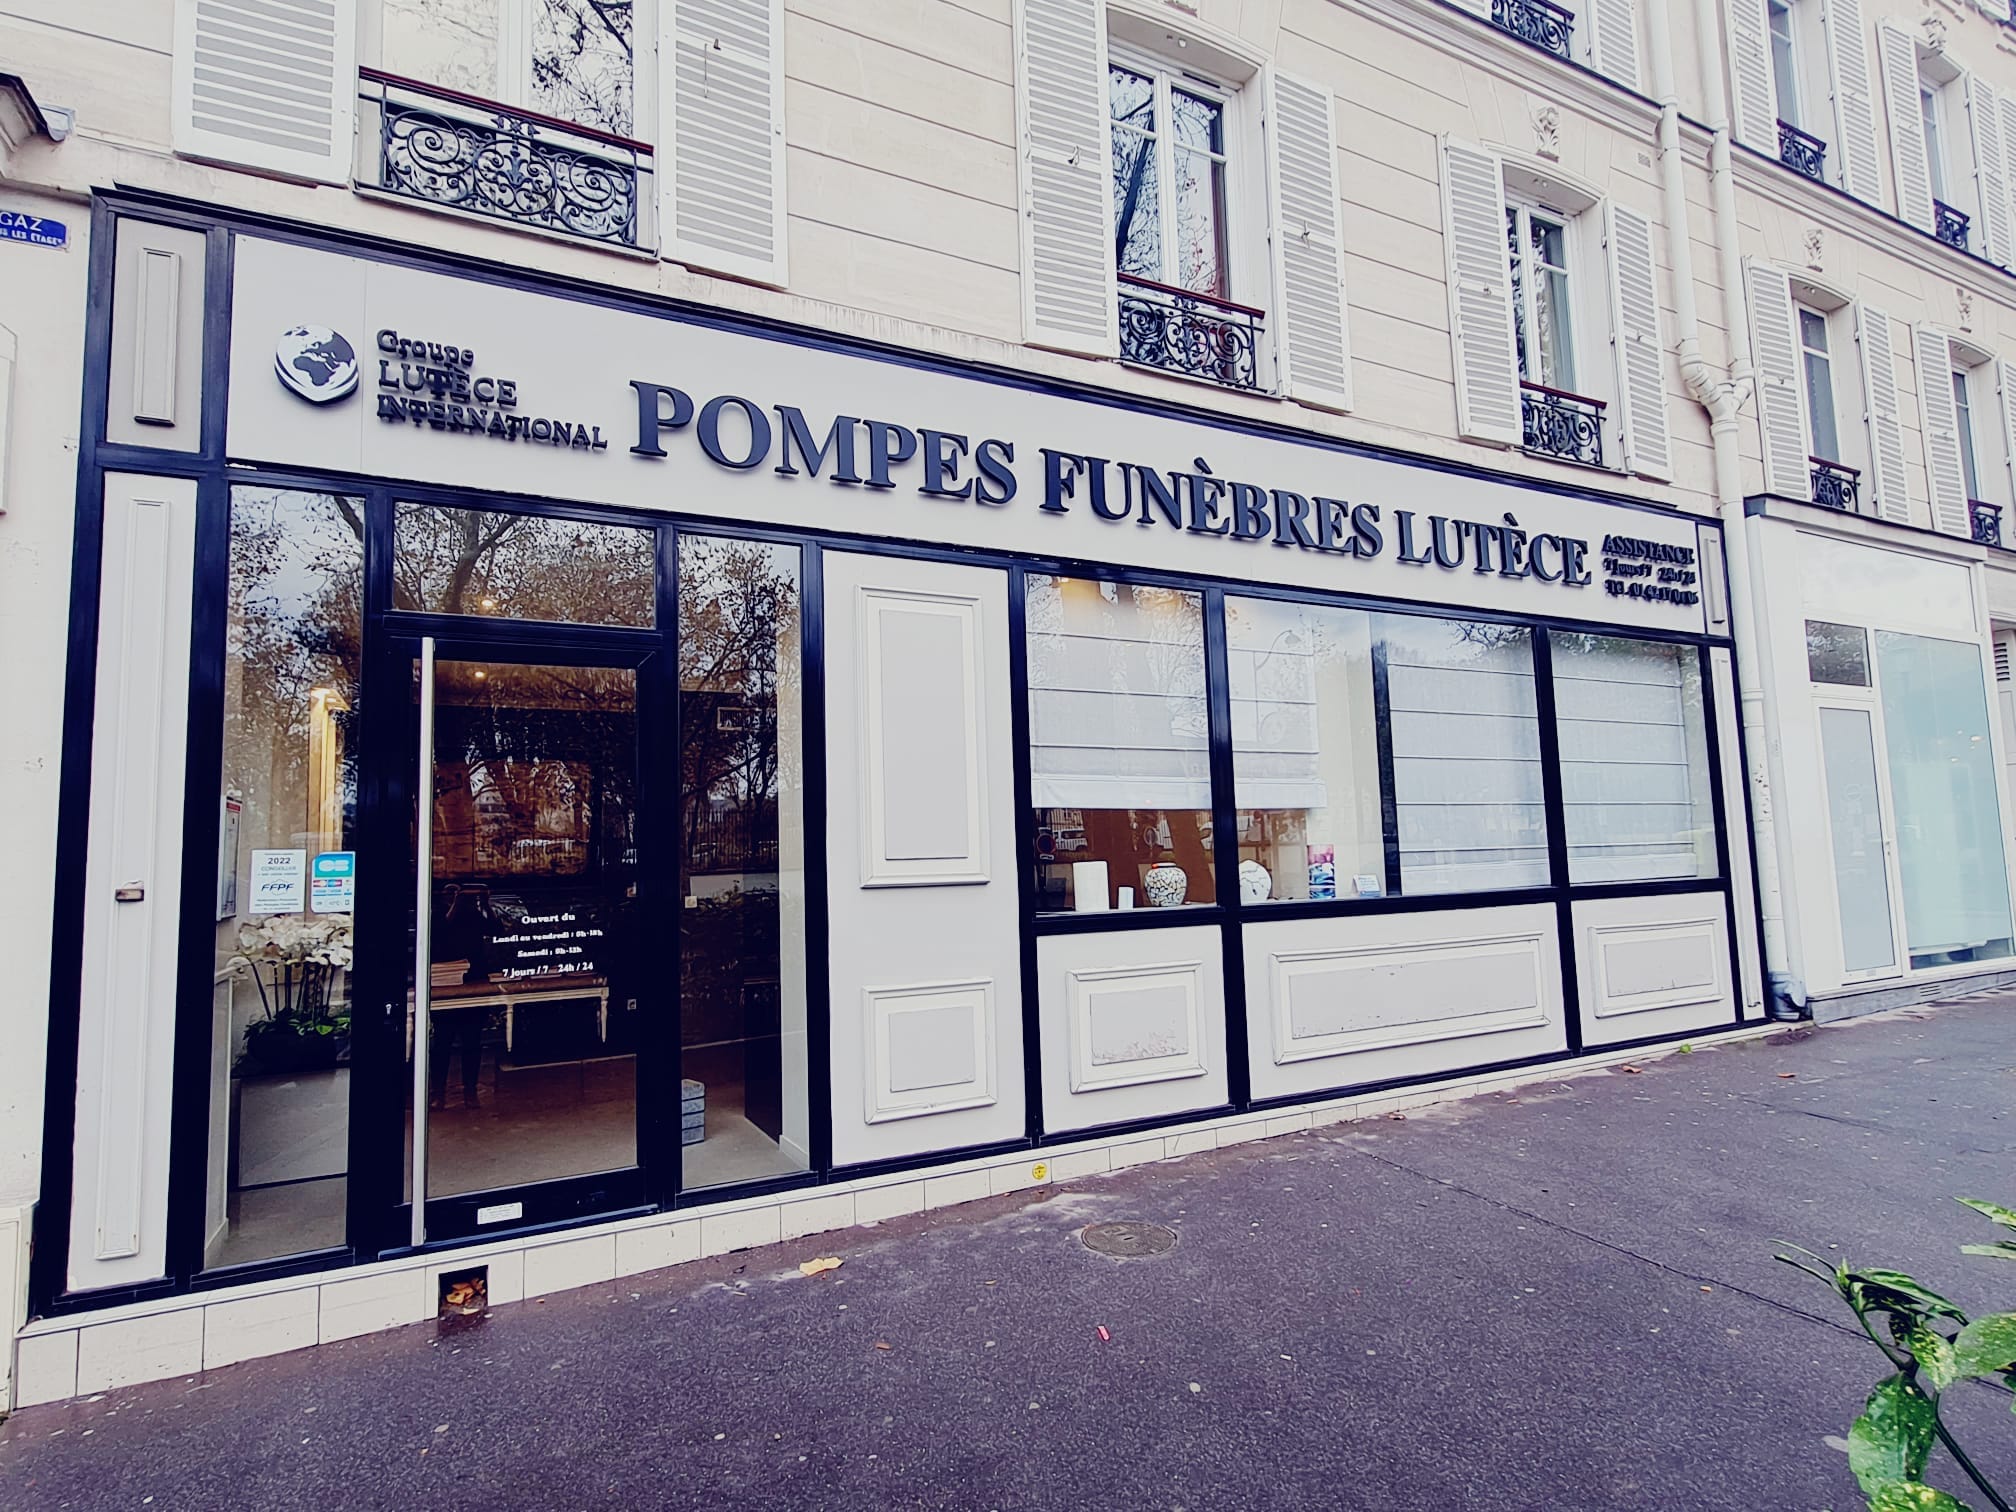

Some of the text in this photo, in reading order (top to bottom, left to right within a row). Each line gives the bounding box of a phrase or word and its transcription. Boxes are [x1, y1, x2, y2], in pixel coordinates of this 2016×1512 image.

[0, 211, 42, 232] GAZ
[377, 329, 474, 367] Groupe
[376, 394, 608, 450] INTERNATIONAL
[628, 379, 1593, 587] POMPES FUNÈBRES LUTÈCE
[1601, 534, 1695, 565] ASSISTANCE
[267, 857, 292, 865] 2022
[261, 882, 295, 892] FFPF
[521, 912, 576, 925] Ouvert du
[492, 934, 519, 944] Lundi
[519, 934, 531, 942] au
[532, 931, 570, 941] vendredi
[517, 948, 549, 958] Samedi
[502, 968, 509, 978] 7
[541, 964, 549, 975] 7
[558, 963, 575, 973] 24h
[582, 961, 594, 971] 24
